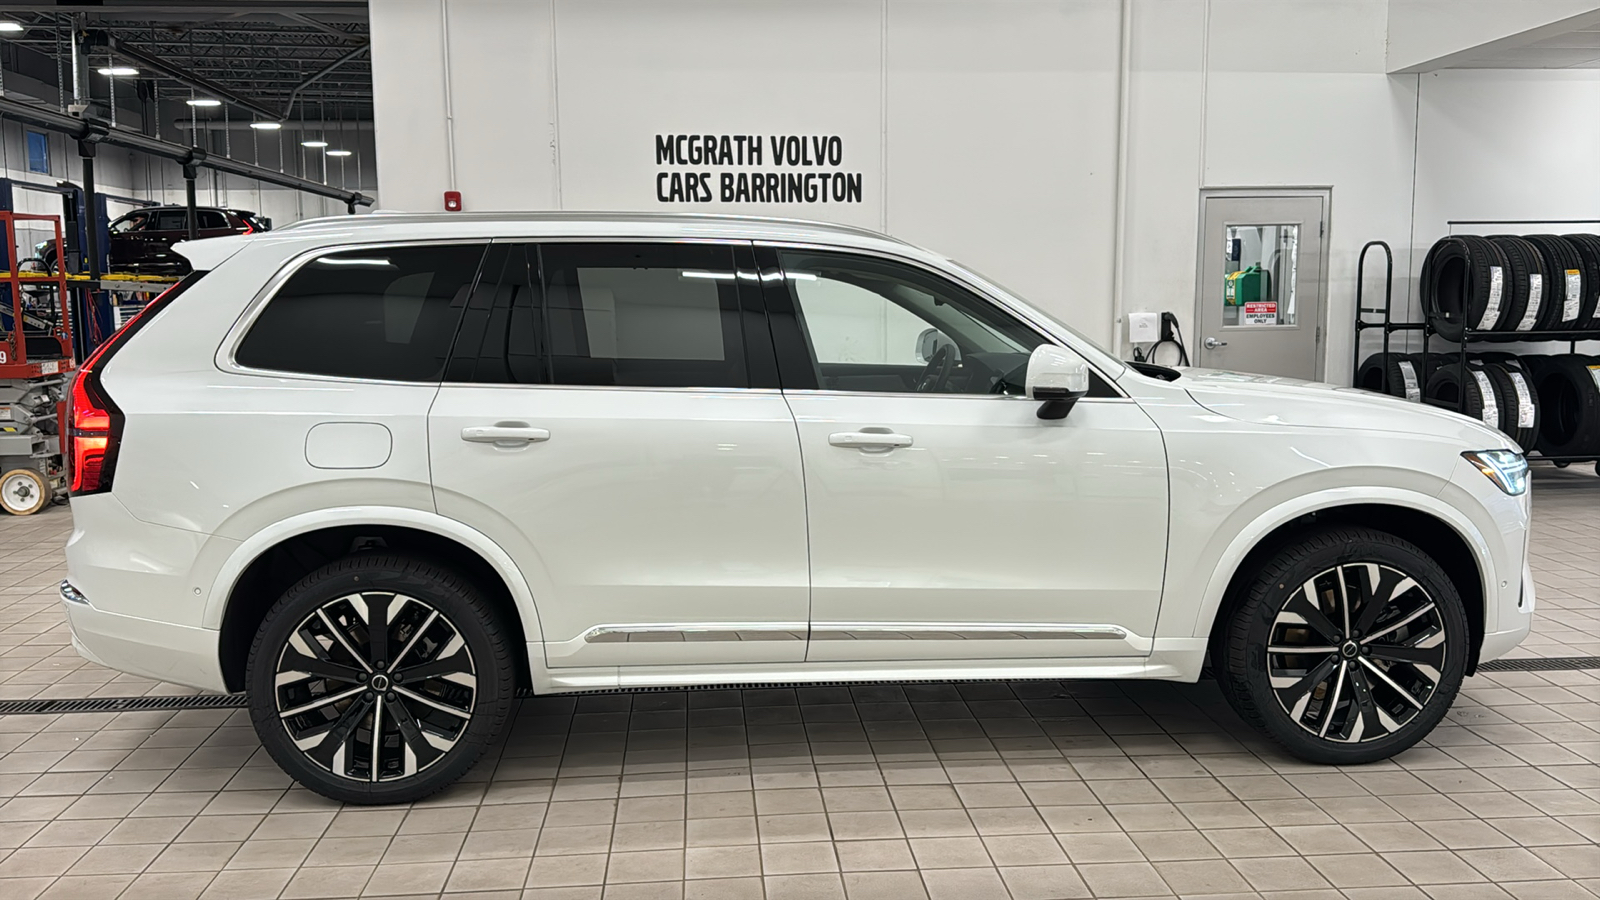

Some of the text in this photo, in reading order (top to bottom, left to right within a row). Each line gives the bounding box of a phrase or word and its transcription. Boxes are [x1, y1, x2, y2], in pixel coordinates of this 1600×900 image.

[655, 134, 842, 166] MCGRATH VOLVO
[656, 172, 862, 203] CARS BARRINGTON
